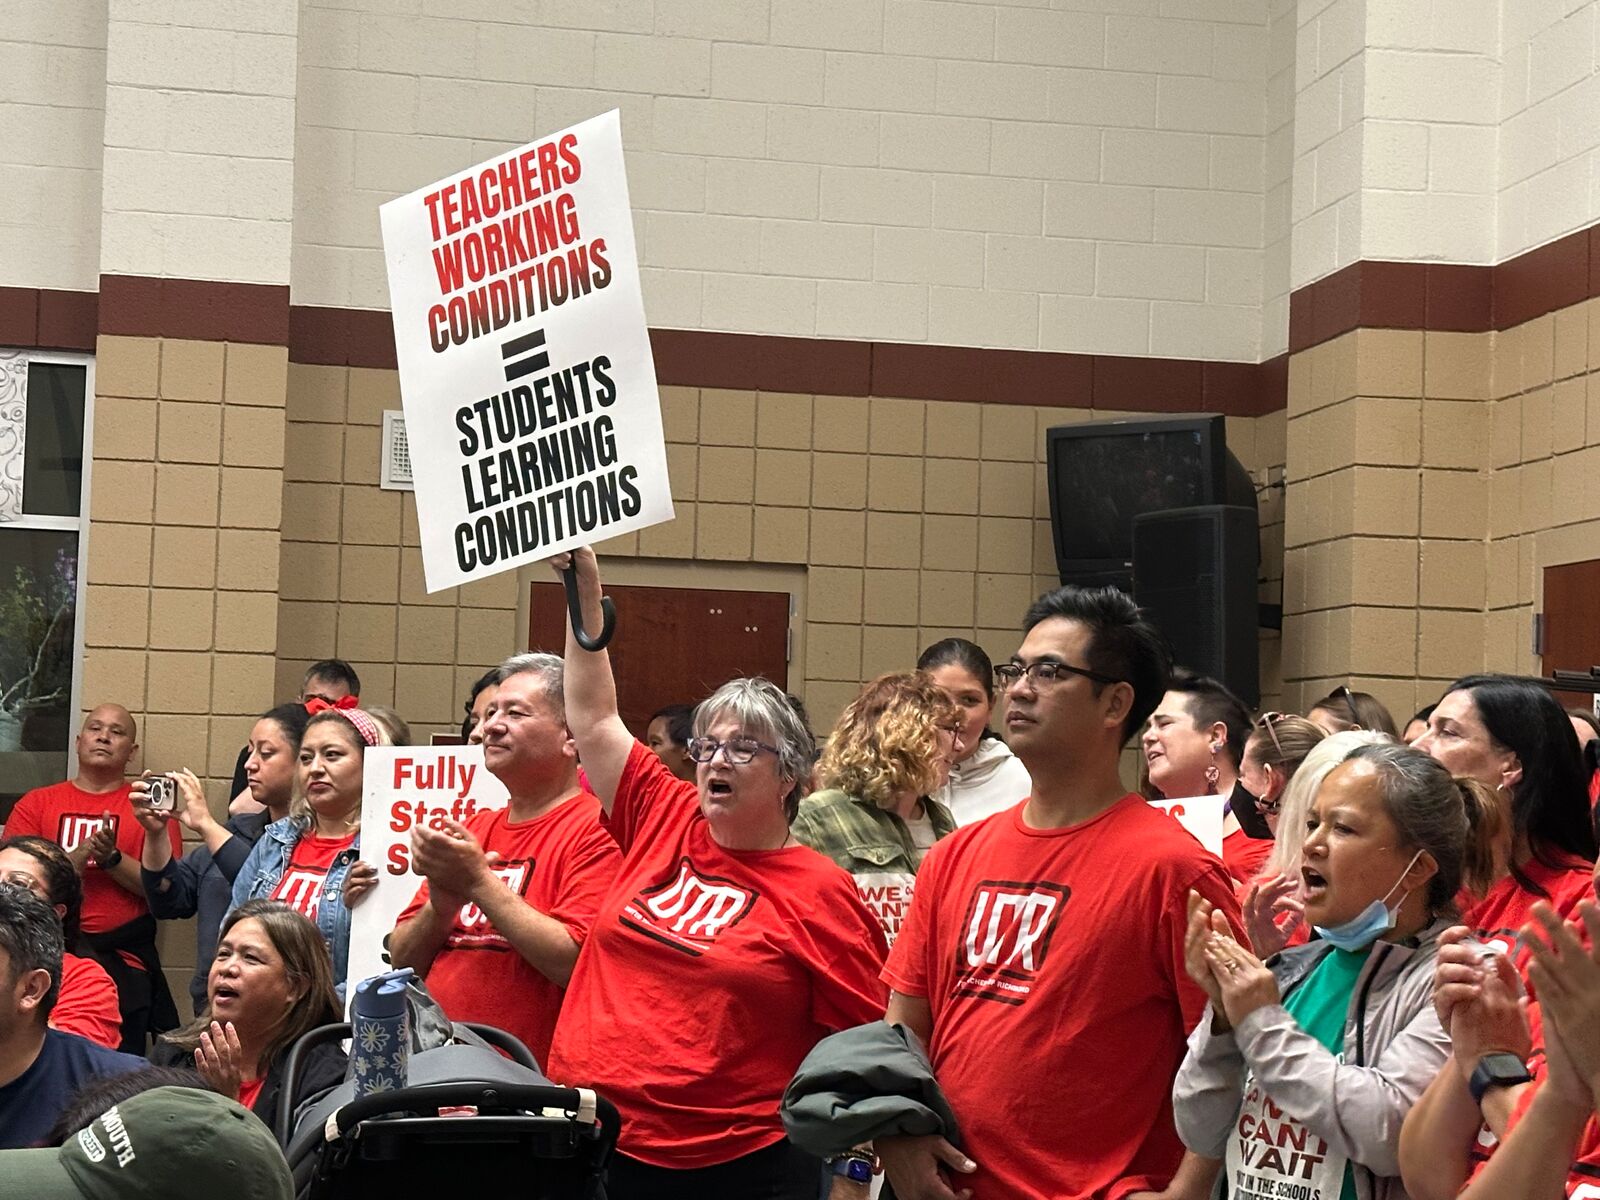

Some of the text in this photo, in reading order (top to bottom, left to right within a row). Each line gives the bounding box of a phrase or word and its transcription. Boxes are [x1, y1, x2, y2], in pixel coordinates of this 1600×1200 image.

[424, 134, 581, 242] TEACHERS
[432, 193, 580, 296] WORKING
[428, 239, 612, 353] CONDITIONS
[455, 355, 616, 457] STUDENTS
[461, 414, 617, 514] LEARNING
[454, 464, 641, 573] CONDITIONS
[389, 799, 491, 833] Staff
[393, 756, 477, 798] Fully
[647, 866, 746, 937] UTR
[858, 886, 902, 902] WE
[966, 891, 1057, 972] UTR
[1257, 1176, 1276, 1196] THE
[1275, 1181, 1321, 1200] SCHOOLS
